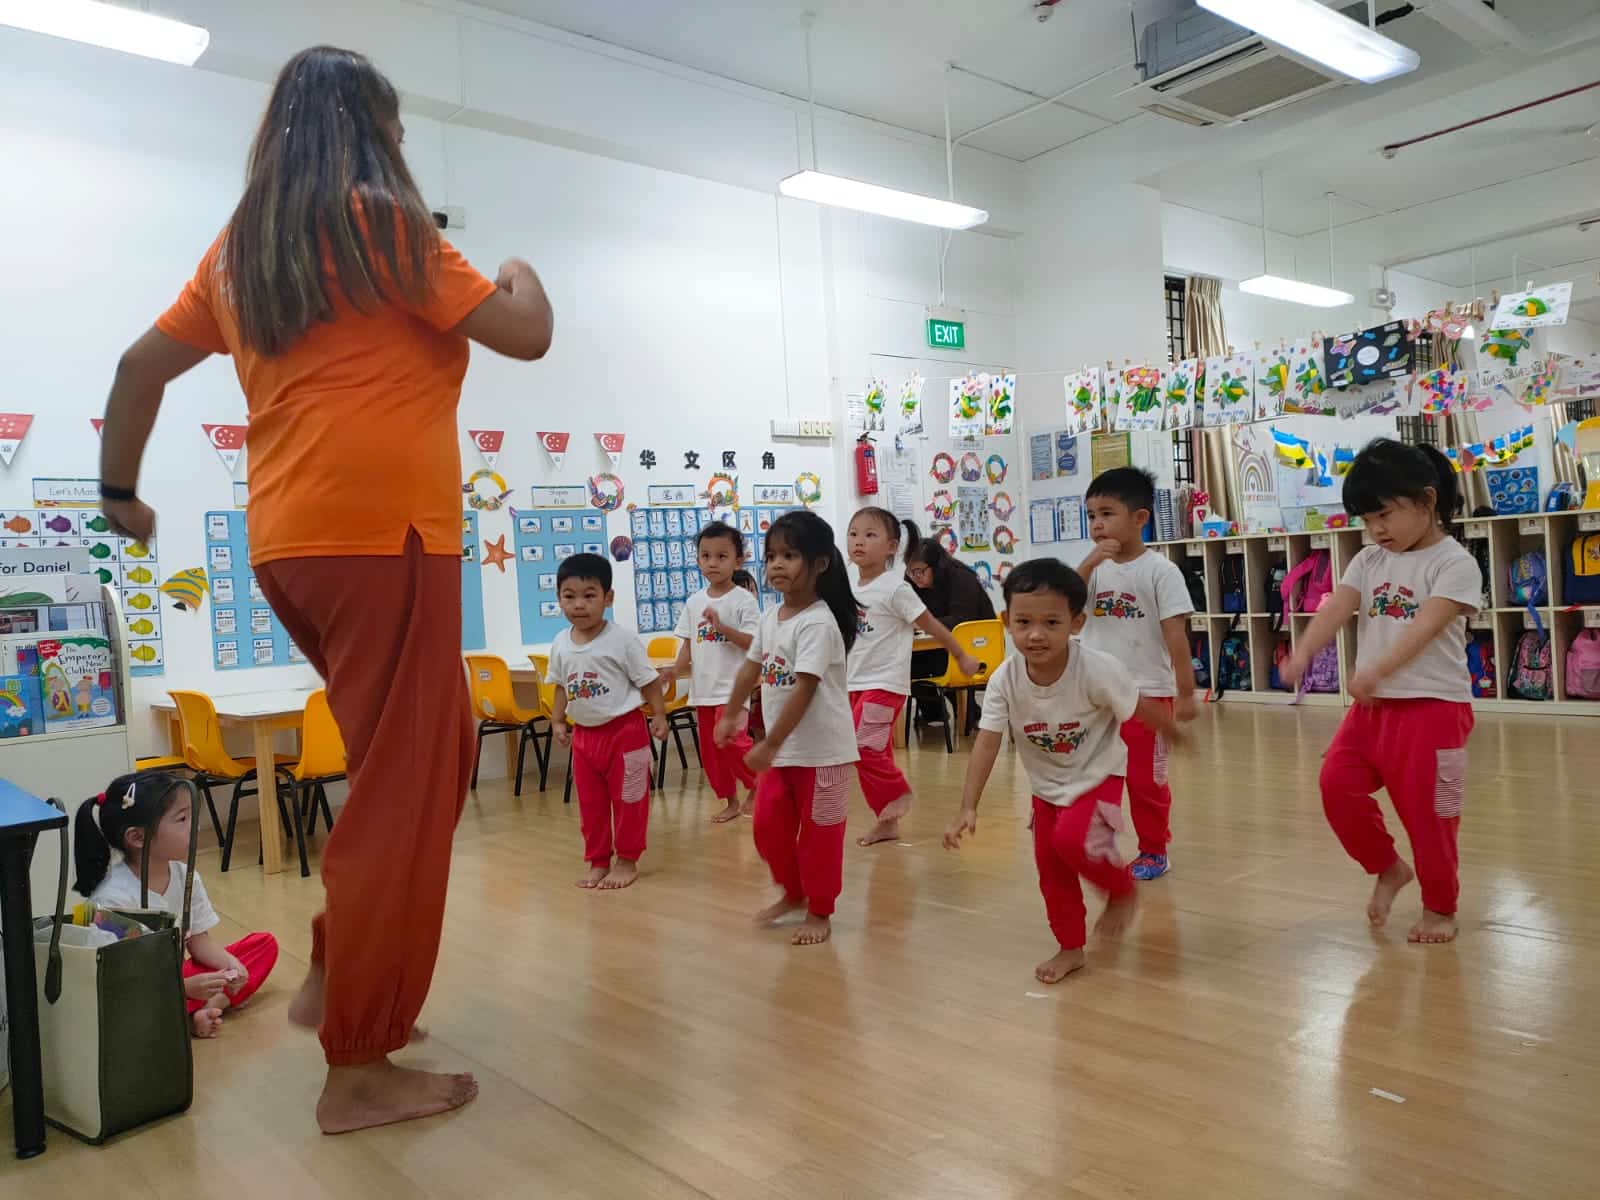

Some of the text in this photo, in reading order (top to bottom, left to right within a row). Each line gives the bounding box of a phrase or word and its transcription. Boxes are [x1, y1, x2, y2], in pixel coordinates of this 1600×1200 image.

[935, 325, 958, 344] EXIT
[639, 449, 775, 470] 华文区角
[23, 561, 71, 573] Daniel
